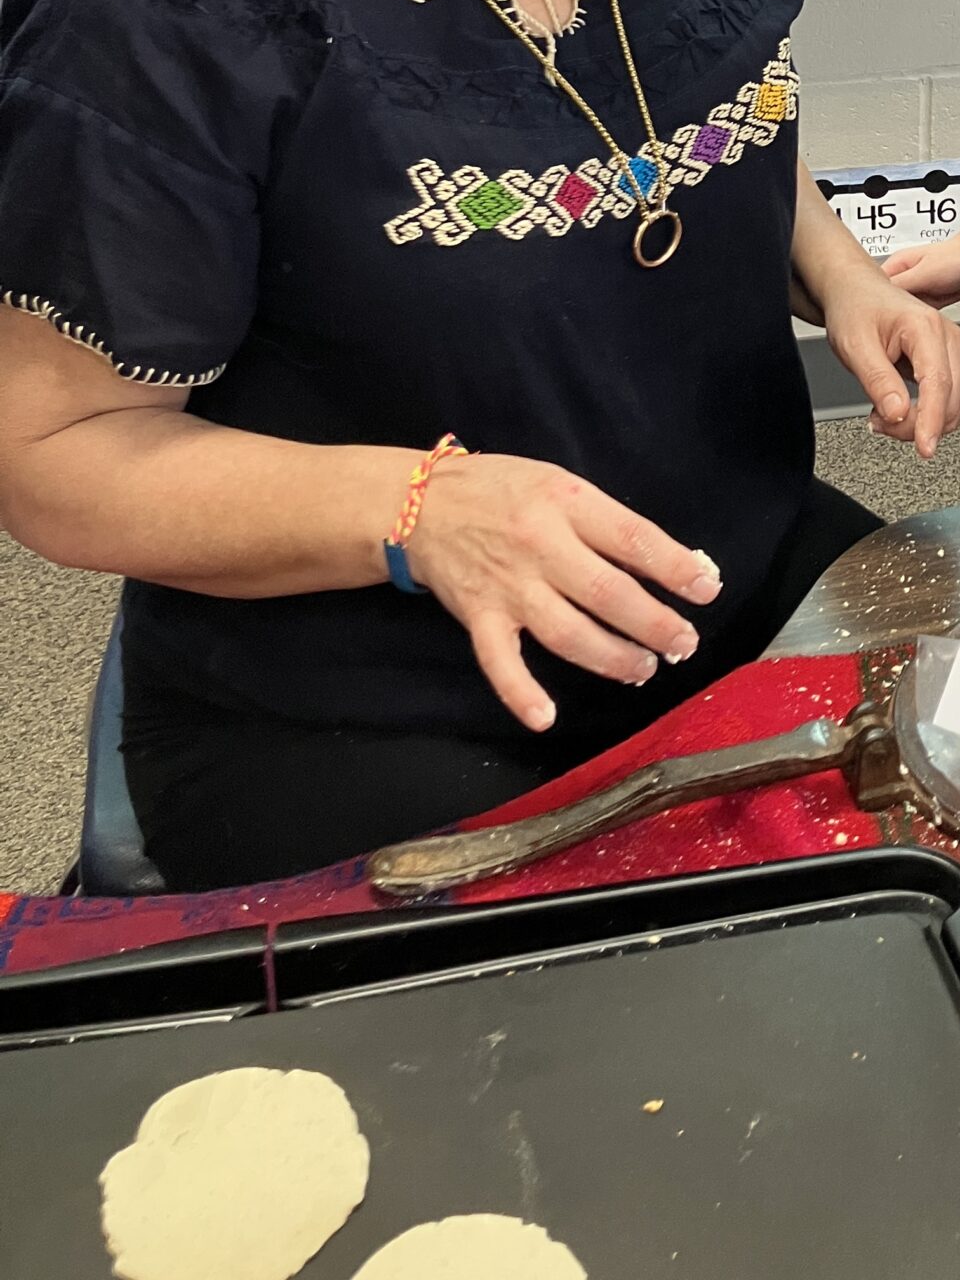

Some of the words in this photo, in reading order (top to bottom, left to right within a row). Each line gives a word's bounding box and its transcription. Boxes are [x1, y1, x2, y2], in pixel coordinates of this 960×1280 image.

[857, 203, 897, 231] 45
[916, 197, 957, 225] 46
[860, 233, 896, 245] forty-
[869, 244, 889, 255] five
